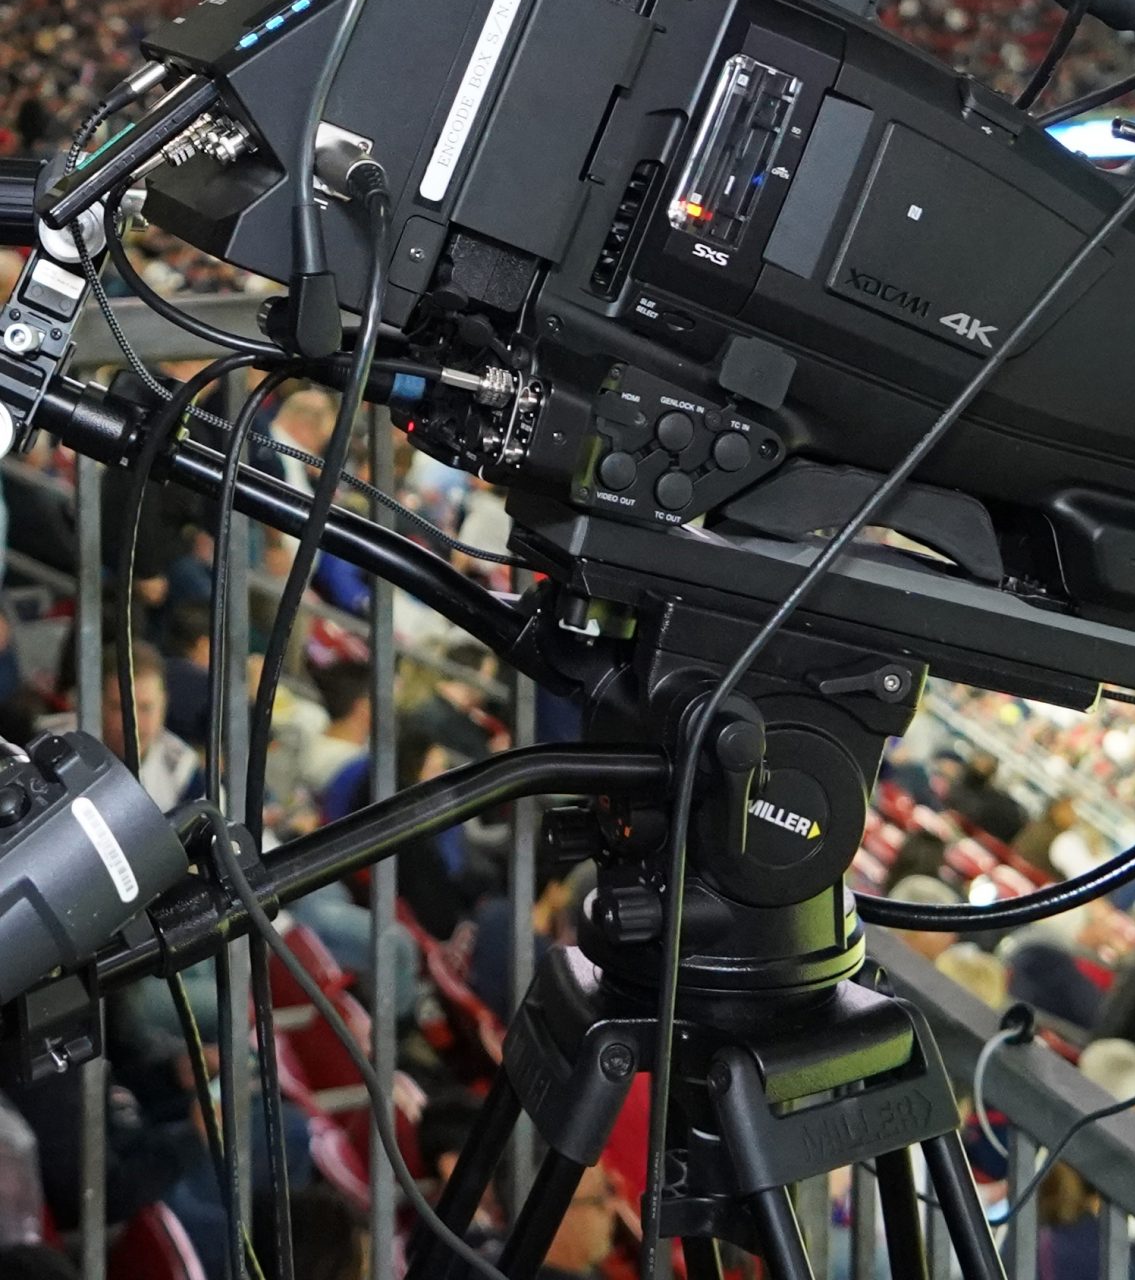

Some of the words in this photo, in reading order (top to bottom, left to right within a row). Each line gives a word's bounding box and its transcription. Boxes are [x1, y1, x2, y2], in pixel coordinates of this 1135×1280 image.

[436, 94, 476, 169] ENCODE
[467, 49, 493, 90] BOX
[845, 268, 932, 318] XDCAM
[635, 305, 660, 320] SELECT
[939, 312, 998, 348] 4K
[621, 392, 641, 403] HDMI
[660, 396, 695, 411] GENLOCK
[596, 491, 619, 503] VIDEO
[619, 496, 636, 507] OUT
[665, 513, 682, 524] OUT
[747, 800, 812, 837] MILLER
